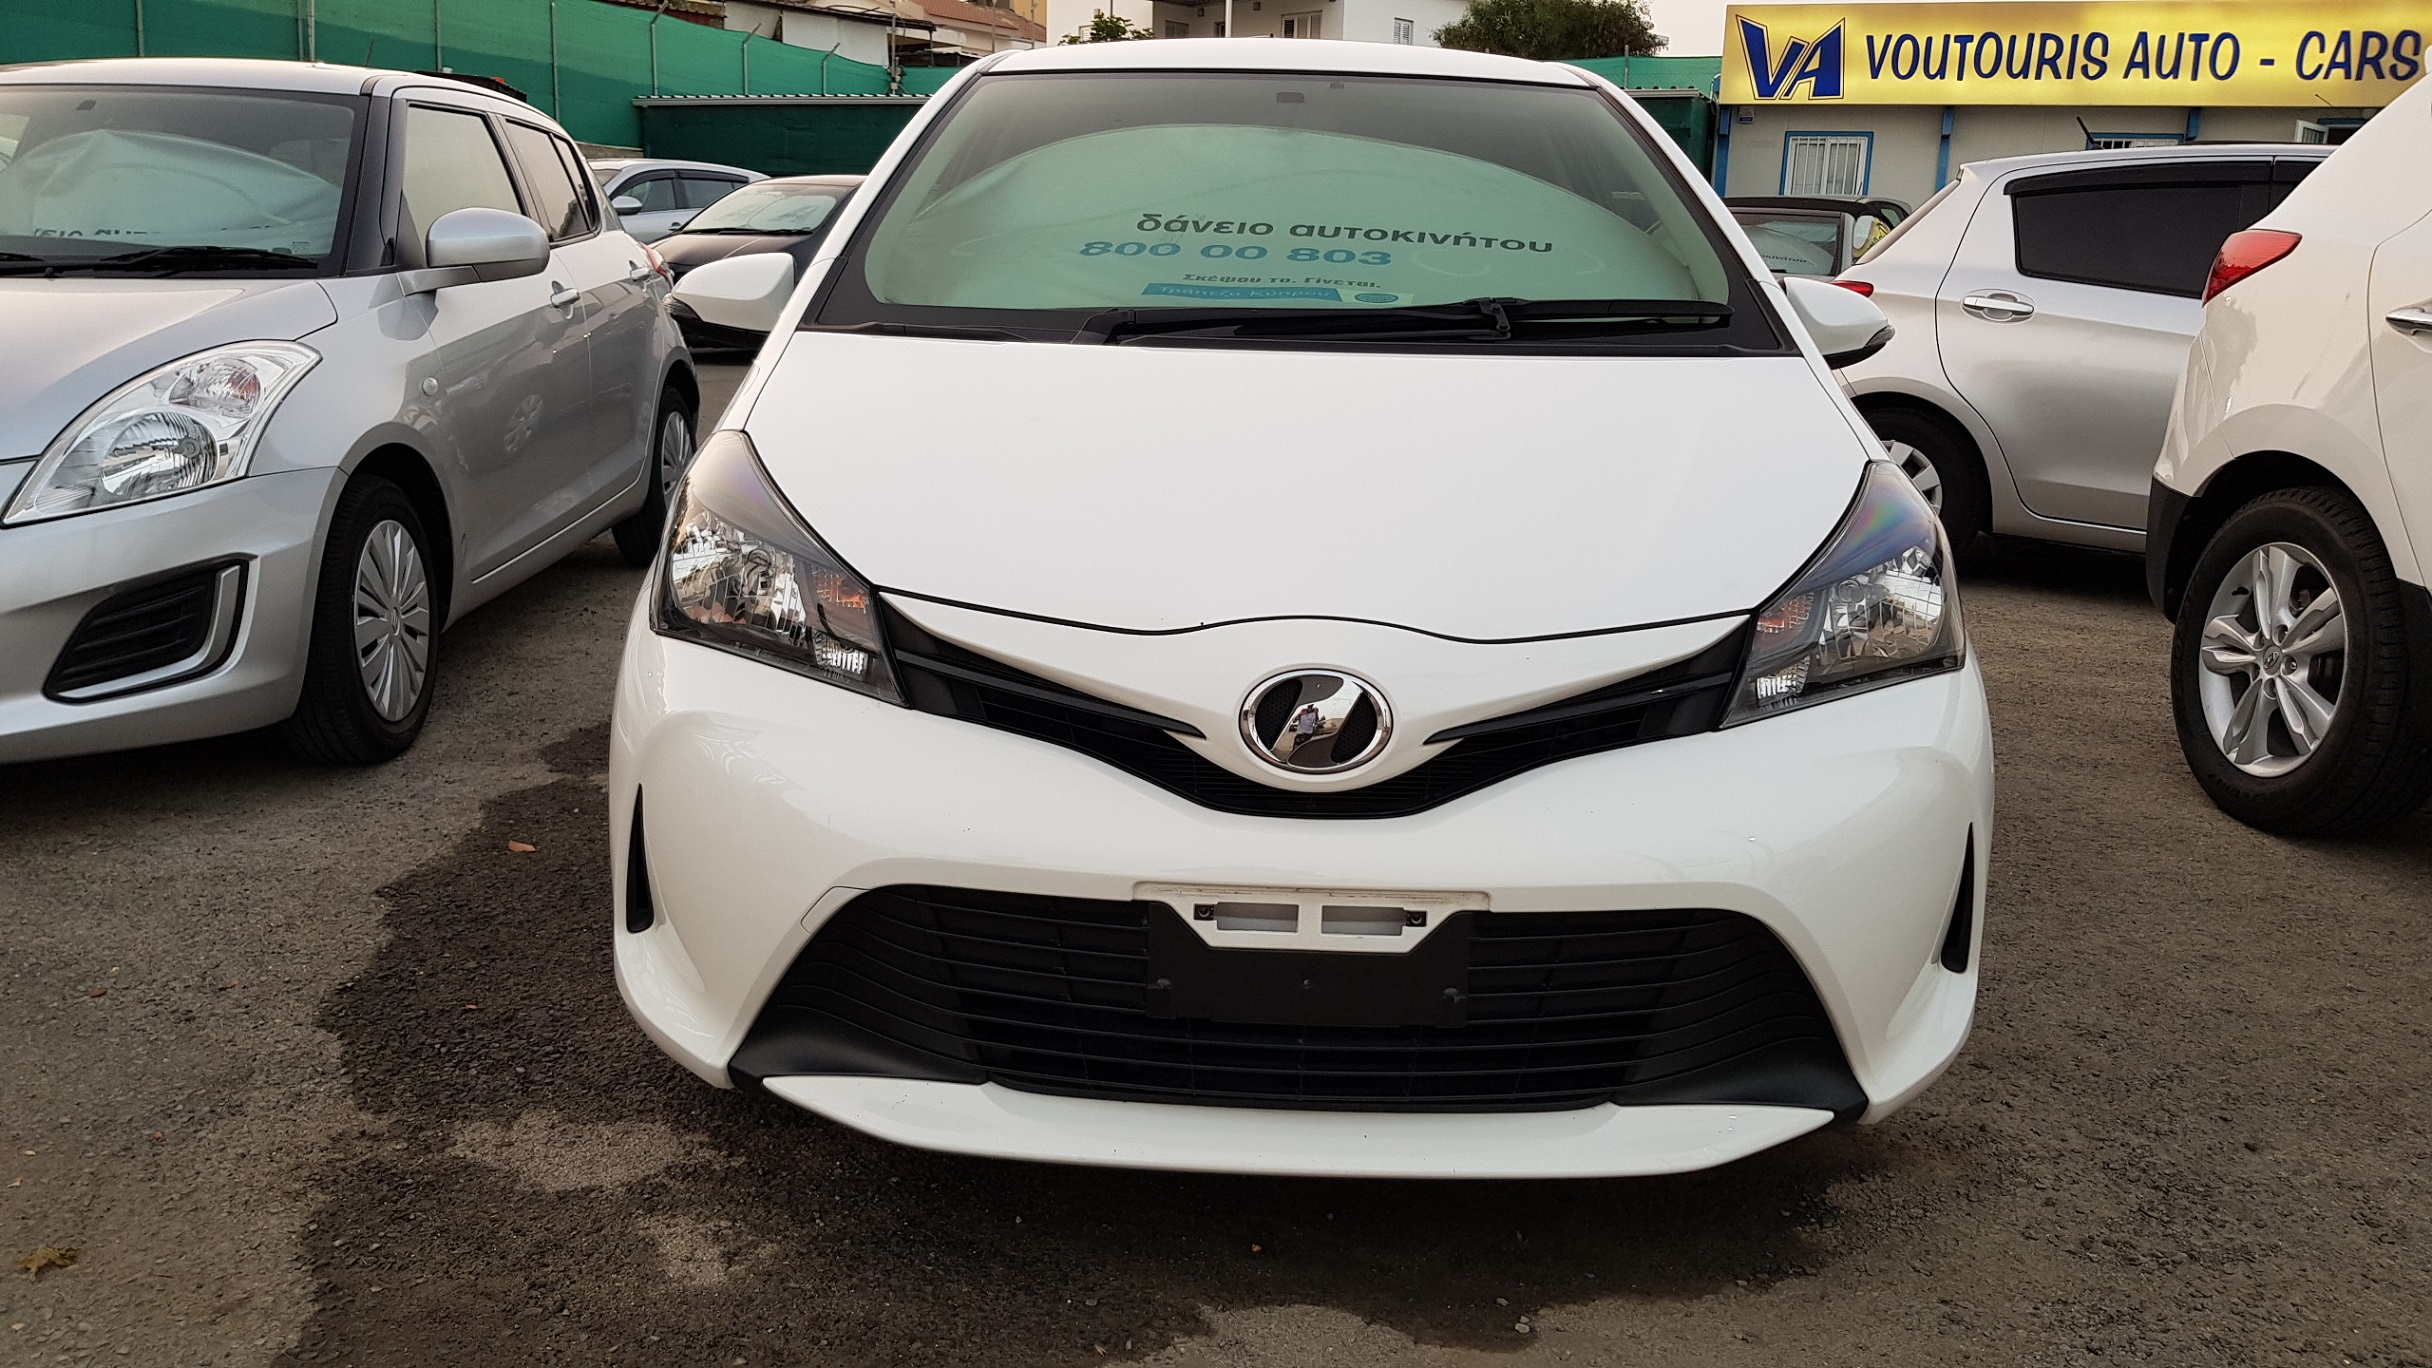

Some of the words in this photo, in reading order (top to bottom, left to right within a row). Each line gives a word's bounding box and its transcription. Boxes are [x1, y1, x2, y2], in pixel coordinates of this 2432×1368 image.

[1736, 14, 1846, 100] VA
[1865, 30, 2110, 81] VOUTOURIS
[2123, 30, 2241, 81] AUTO
[2296, 28, 2421, 81] CARS
[1079, 241, 1181, 258] 800
[1199, 244, 1268, 261] 00
[1286, 247, 1392, 266] 803
[1136, 213, 1274, 236] δάνειο
[1289, 222, 1553, 253] αυτοκινήτου
